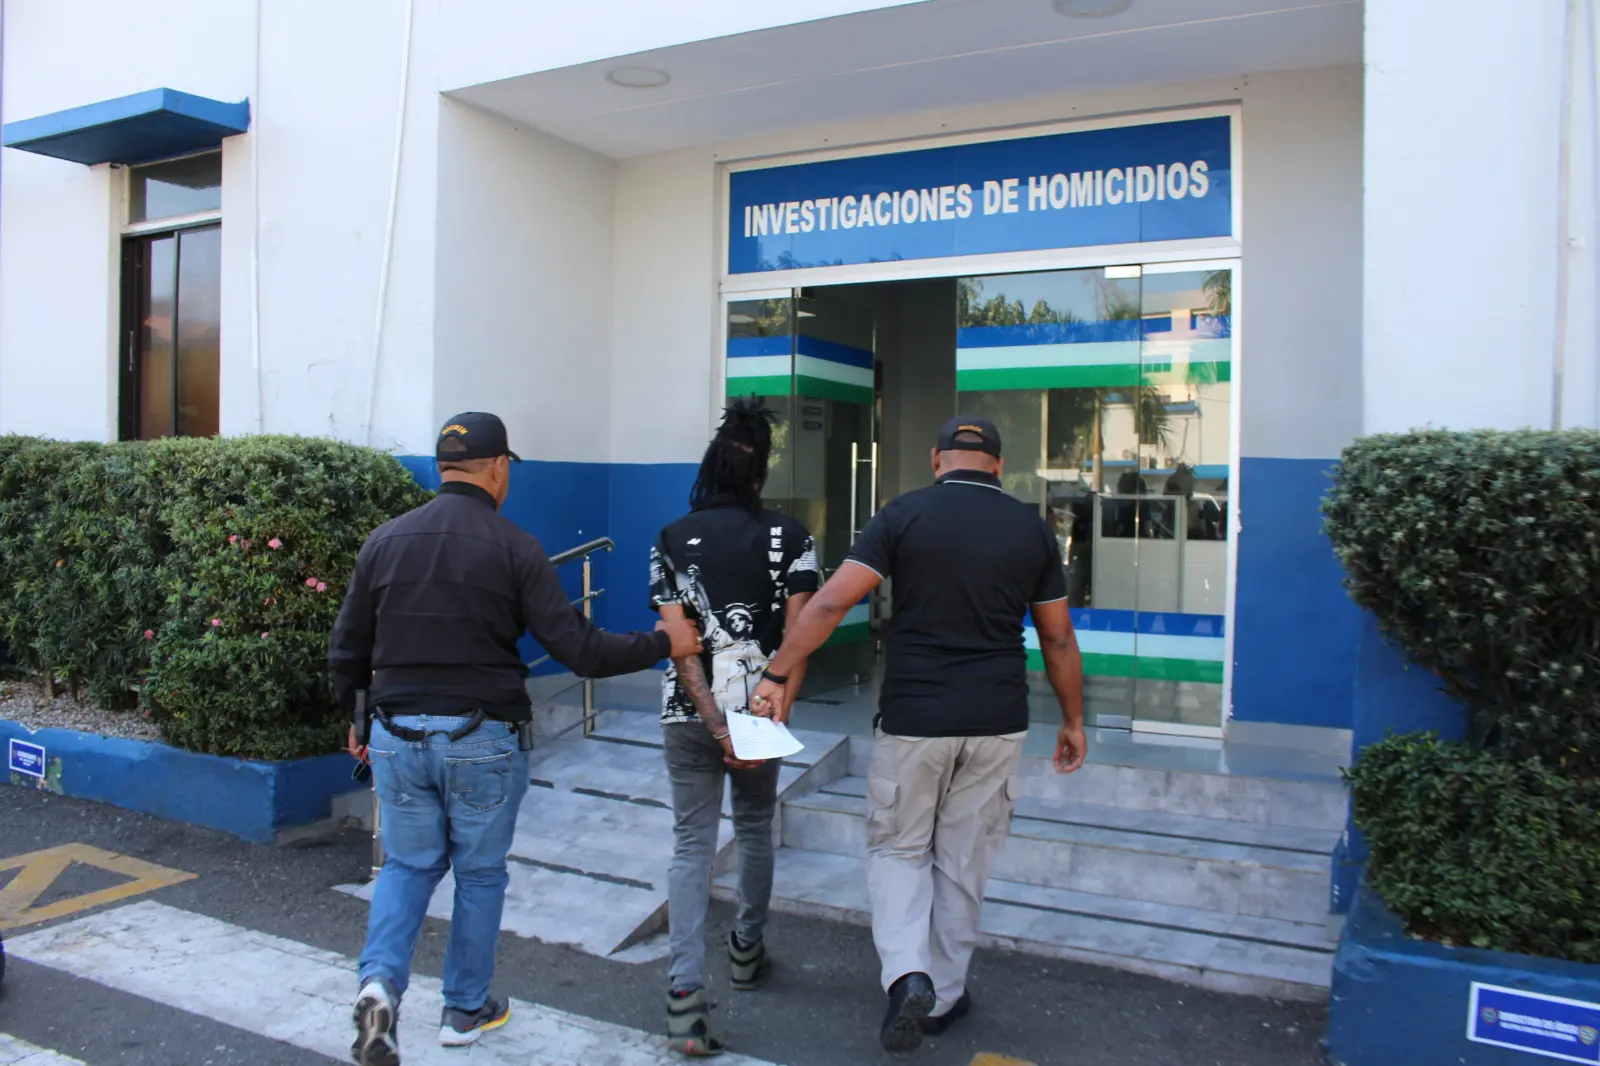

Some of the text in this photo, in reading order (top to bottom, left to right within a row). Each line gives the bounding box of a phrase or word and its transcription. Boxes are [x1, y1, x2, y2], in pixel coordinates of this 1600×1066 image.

[744, 160, 1209, 238] INVESTIGACIONES DE HOMICIDIOS
[768, 526, 784, 563] NEW
